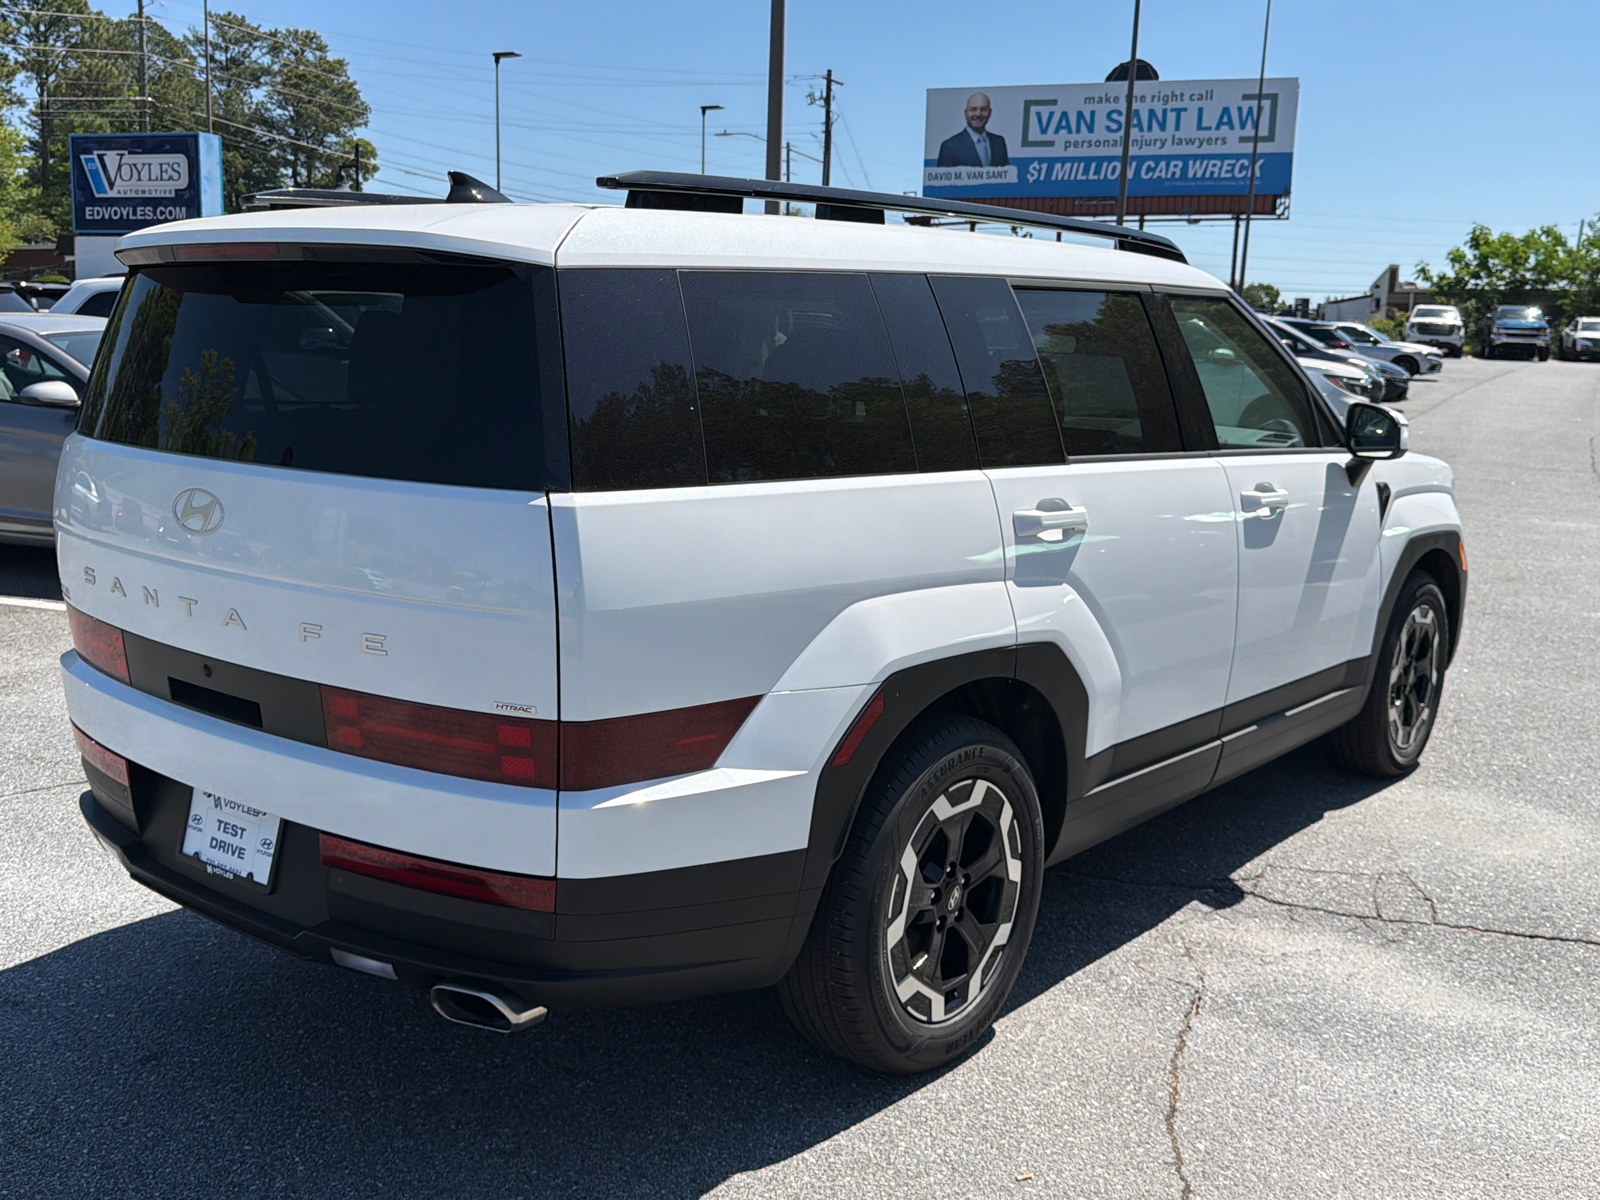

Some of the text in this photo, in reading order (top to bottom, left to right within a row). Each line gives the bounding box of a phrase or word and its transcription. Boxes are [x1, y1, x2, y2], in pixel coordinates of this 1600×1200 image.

[1084, 93, 1120, 105] make
[1151, 90, 1184, 106] right
[1189, 90, 1214, 102] call
[1035, 105, 1264, 135] VAN SANT LAW
[1064, 134, 1228, 152] personal njury lawyers
[96, 153, 182, 191] VOYLES
[927, 170, 1009, 182] DAVID M. VAN SANT
[1026, 158, 1265, 183] $1 MILLION CAR WRECK
[85, 206, 186, 220] EDVOYLES.COM
[83, 565, 388, 657] SANTA FE
[495, 703, 533, 714] HTRAC
[919, 746, 986, 798] ASSURANCE
[223, 798, 260, 817] VOYLES
[216, 819, 247, 840] TEST
[209, 836, 247, 860] DRIVE
